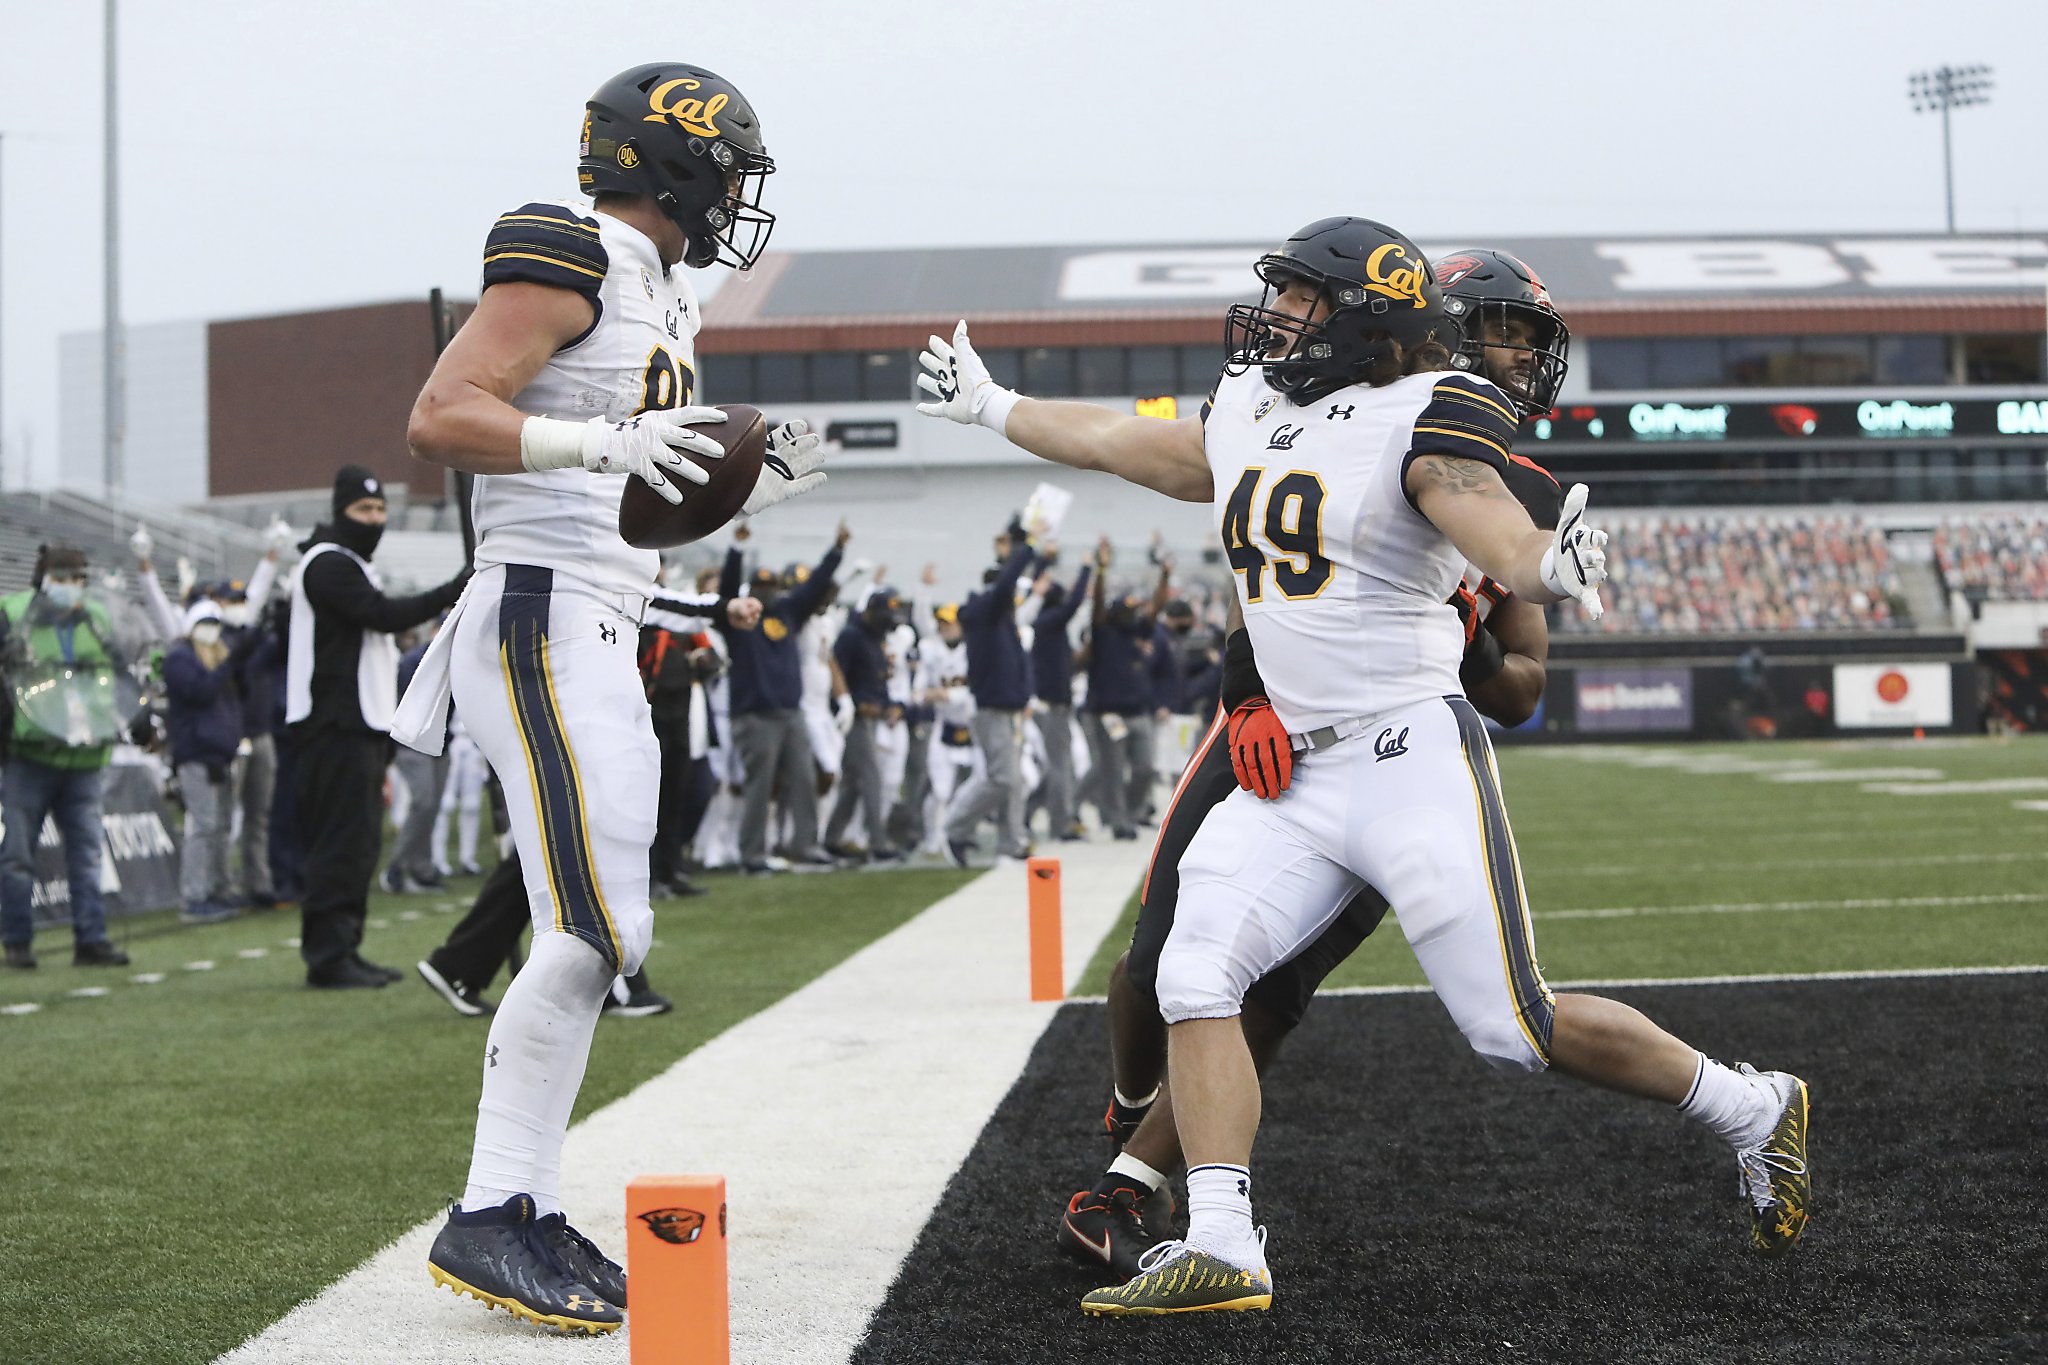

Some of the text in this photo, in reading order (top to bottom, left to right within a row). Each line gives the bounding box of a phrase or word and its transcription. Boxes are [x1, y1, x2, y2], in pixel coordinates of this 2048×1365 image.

[643, 78, 729, 138] Cal
[1364, 243, 1427, 309] Cal
[665, 309, 679, 340] Cal
[1265, 423, 1304, 451] Cal
[1221, 466, 1336, 604] 49
[1373, 726, 1410, 763] Cal
